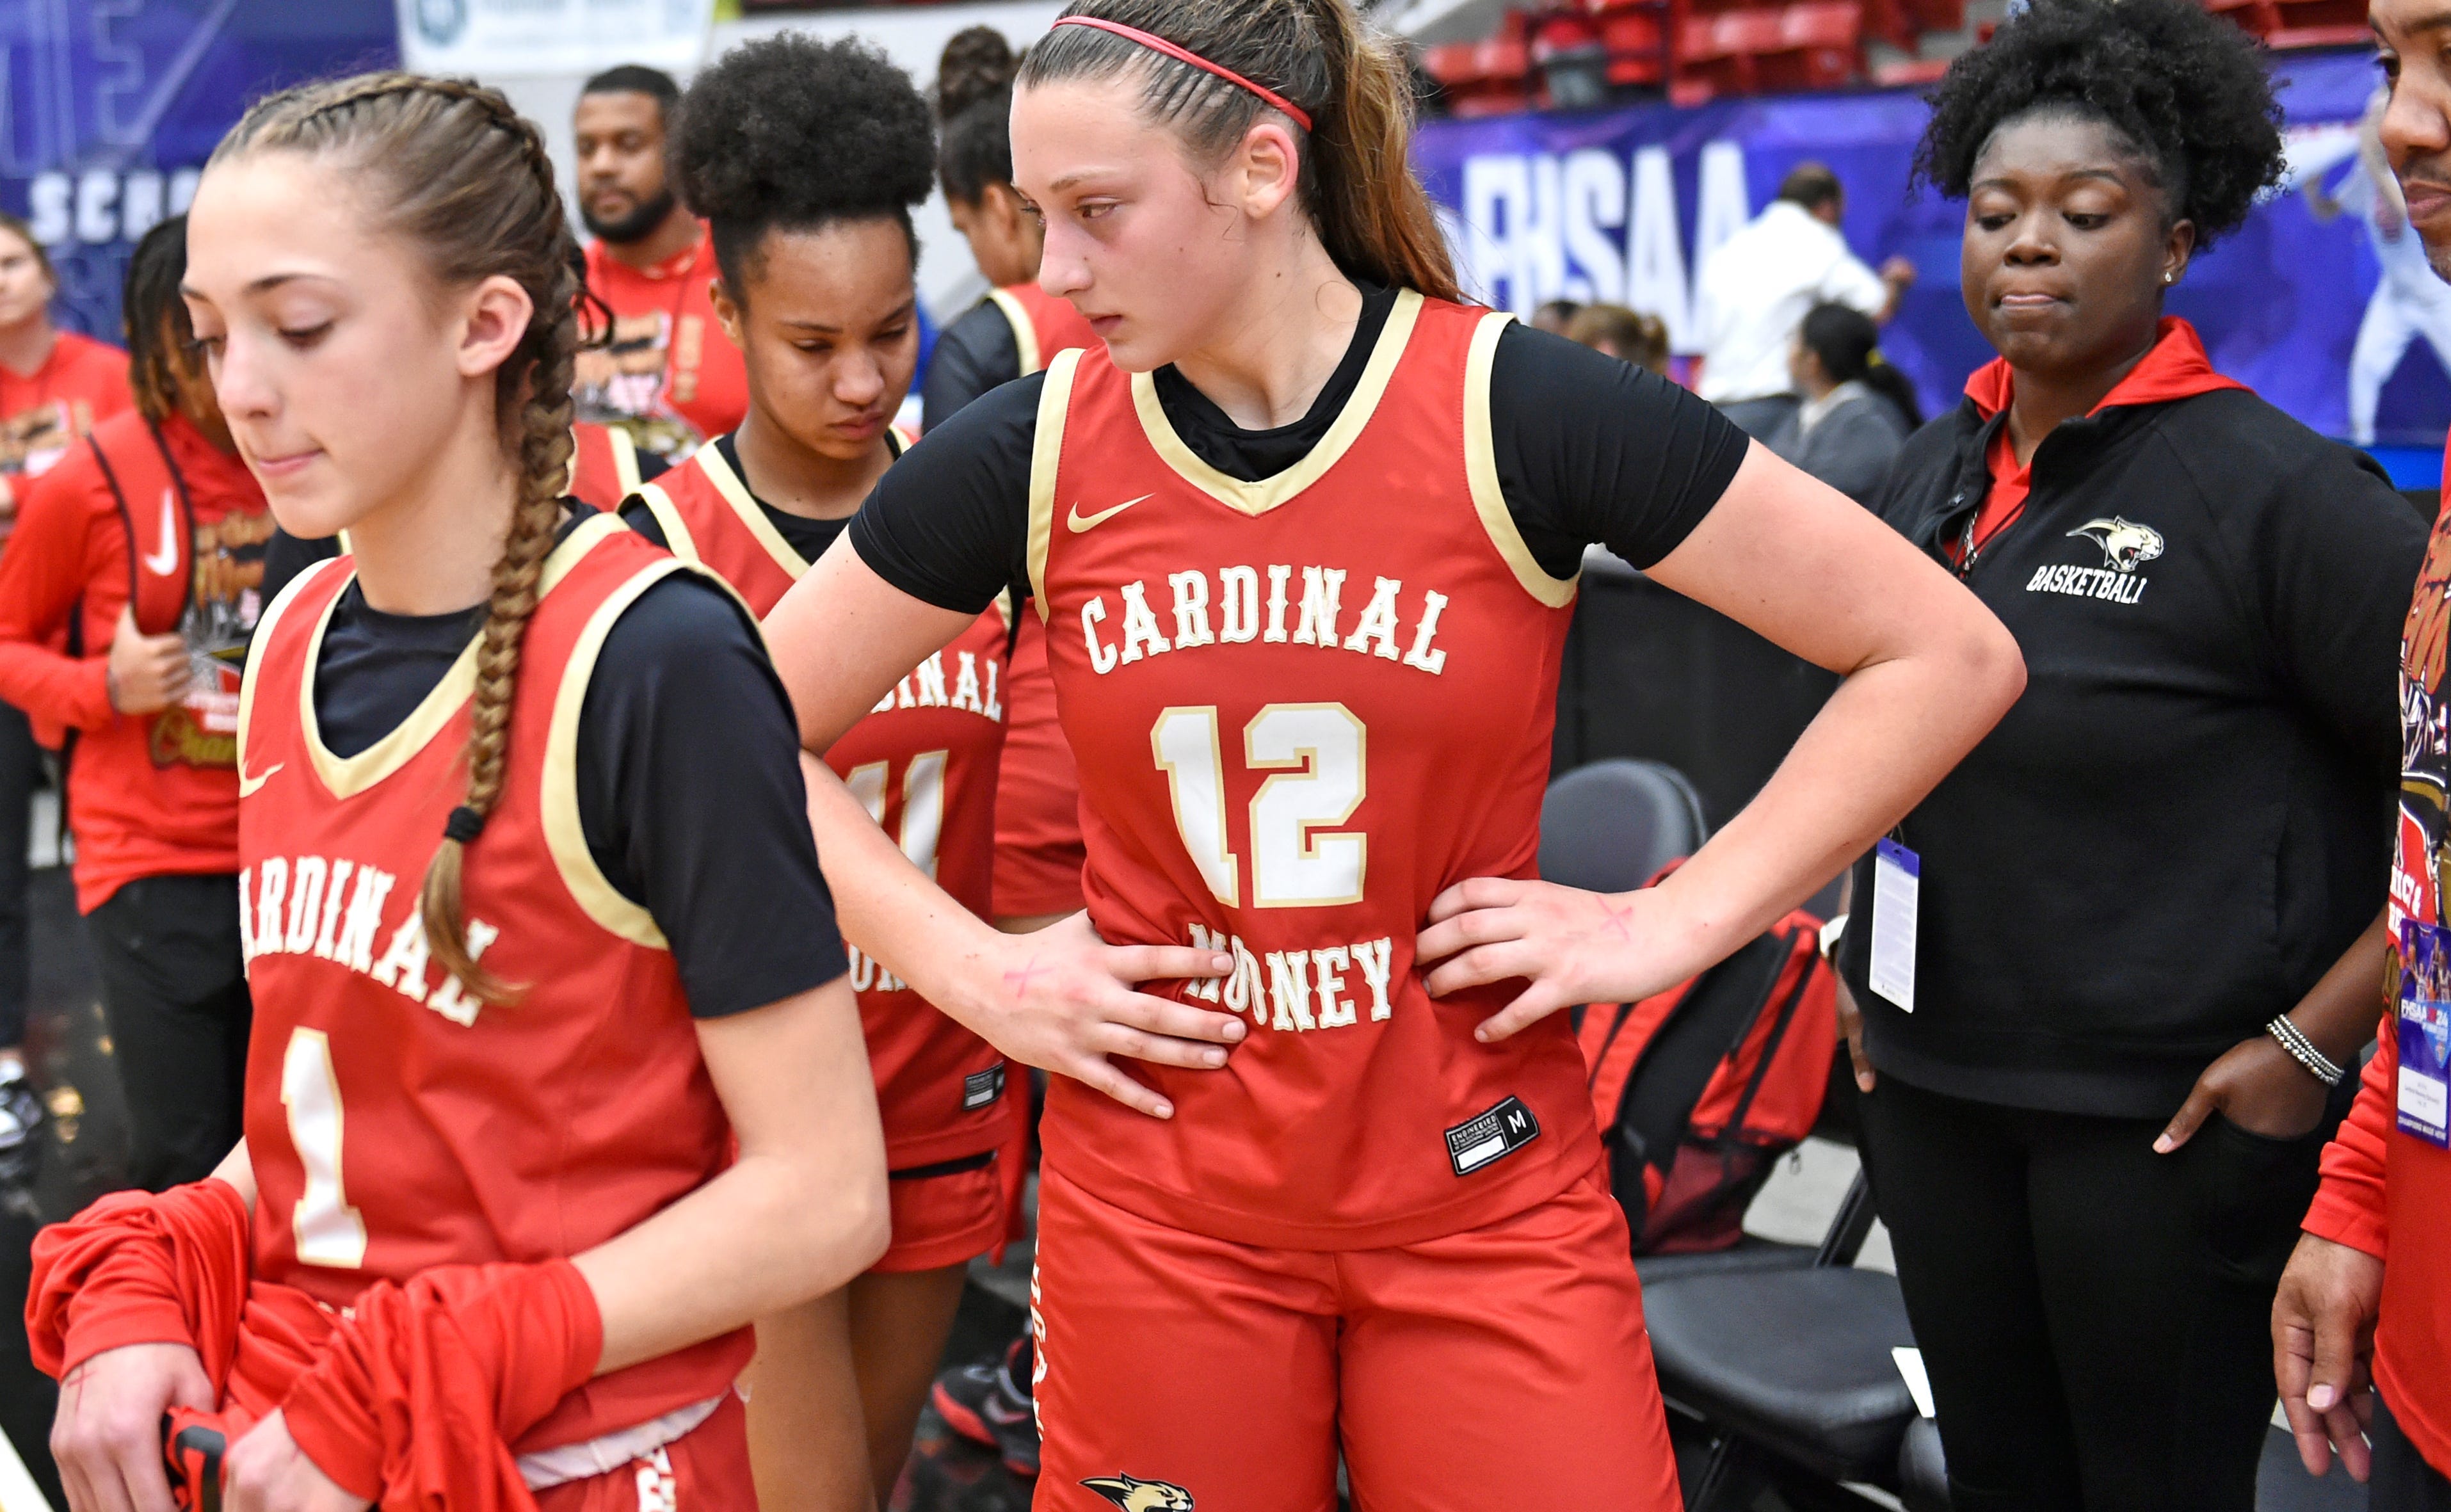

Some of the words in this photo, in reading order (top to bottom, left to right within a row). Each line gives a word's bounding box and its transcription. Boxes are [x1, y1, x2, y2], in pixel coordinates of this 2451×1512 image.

[1081, 564, 1449, 675] CARDINAL
[2026, 565, 2148, 604] BASKETBALL
[869, 650, 1002, 723] INAL
[1150, 702, 1367, 909] 12
[280, 1025, 368, 1269] 1
[1507, 1109, 1527, 1134] M
